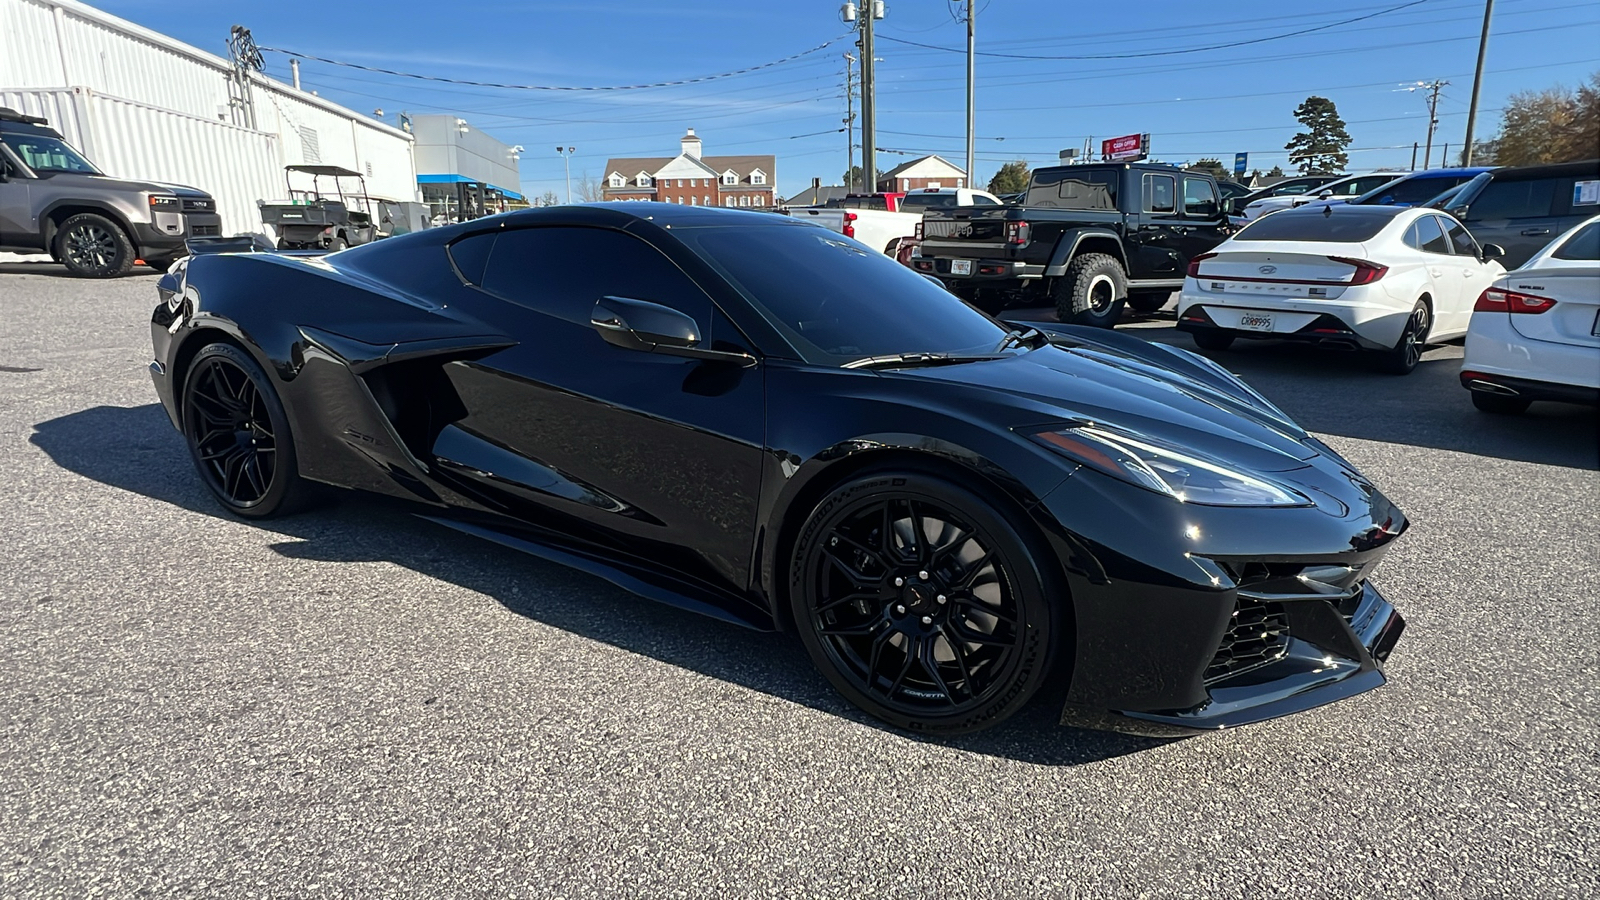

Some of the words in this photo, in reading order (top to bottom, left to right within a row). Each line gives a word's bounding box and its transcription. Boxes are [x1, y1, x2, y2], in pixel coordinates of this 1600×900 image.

[951, 223, 973, 237] Jeep
[1229, 284, 1302, 292] SONATA
[1241, 316, 1271, 328] CRR9995
